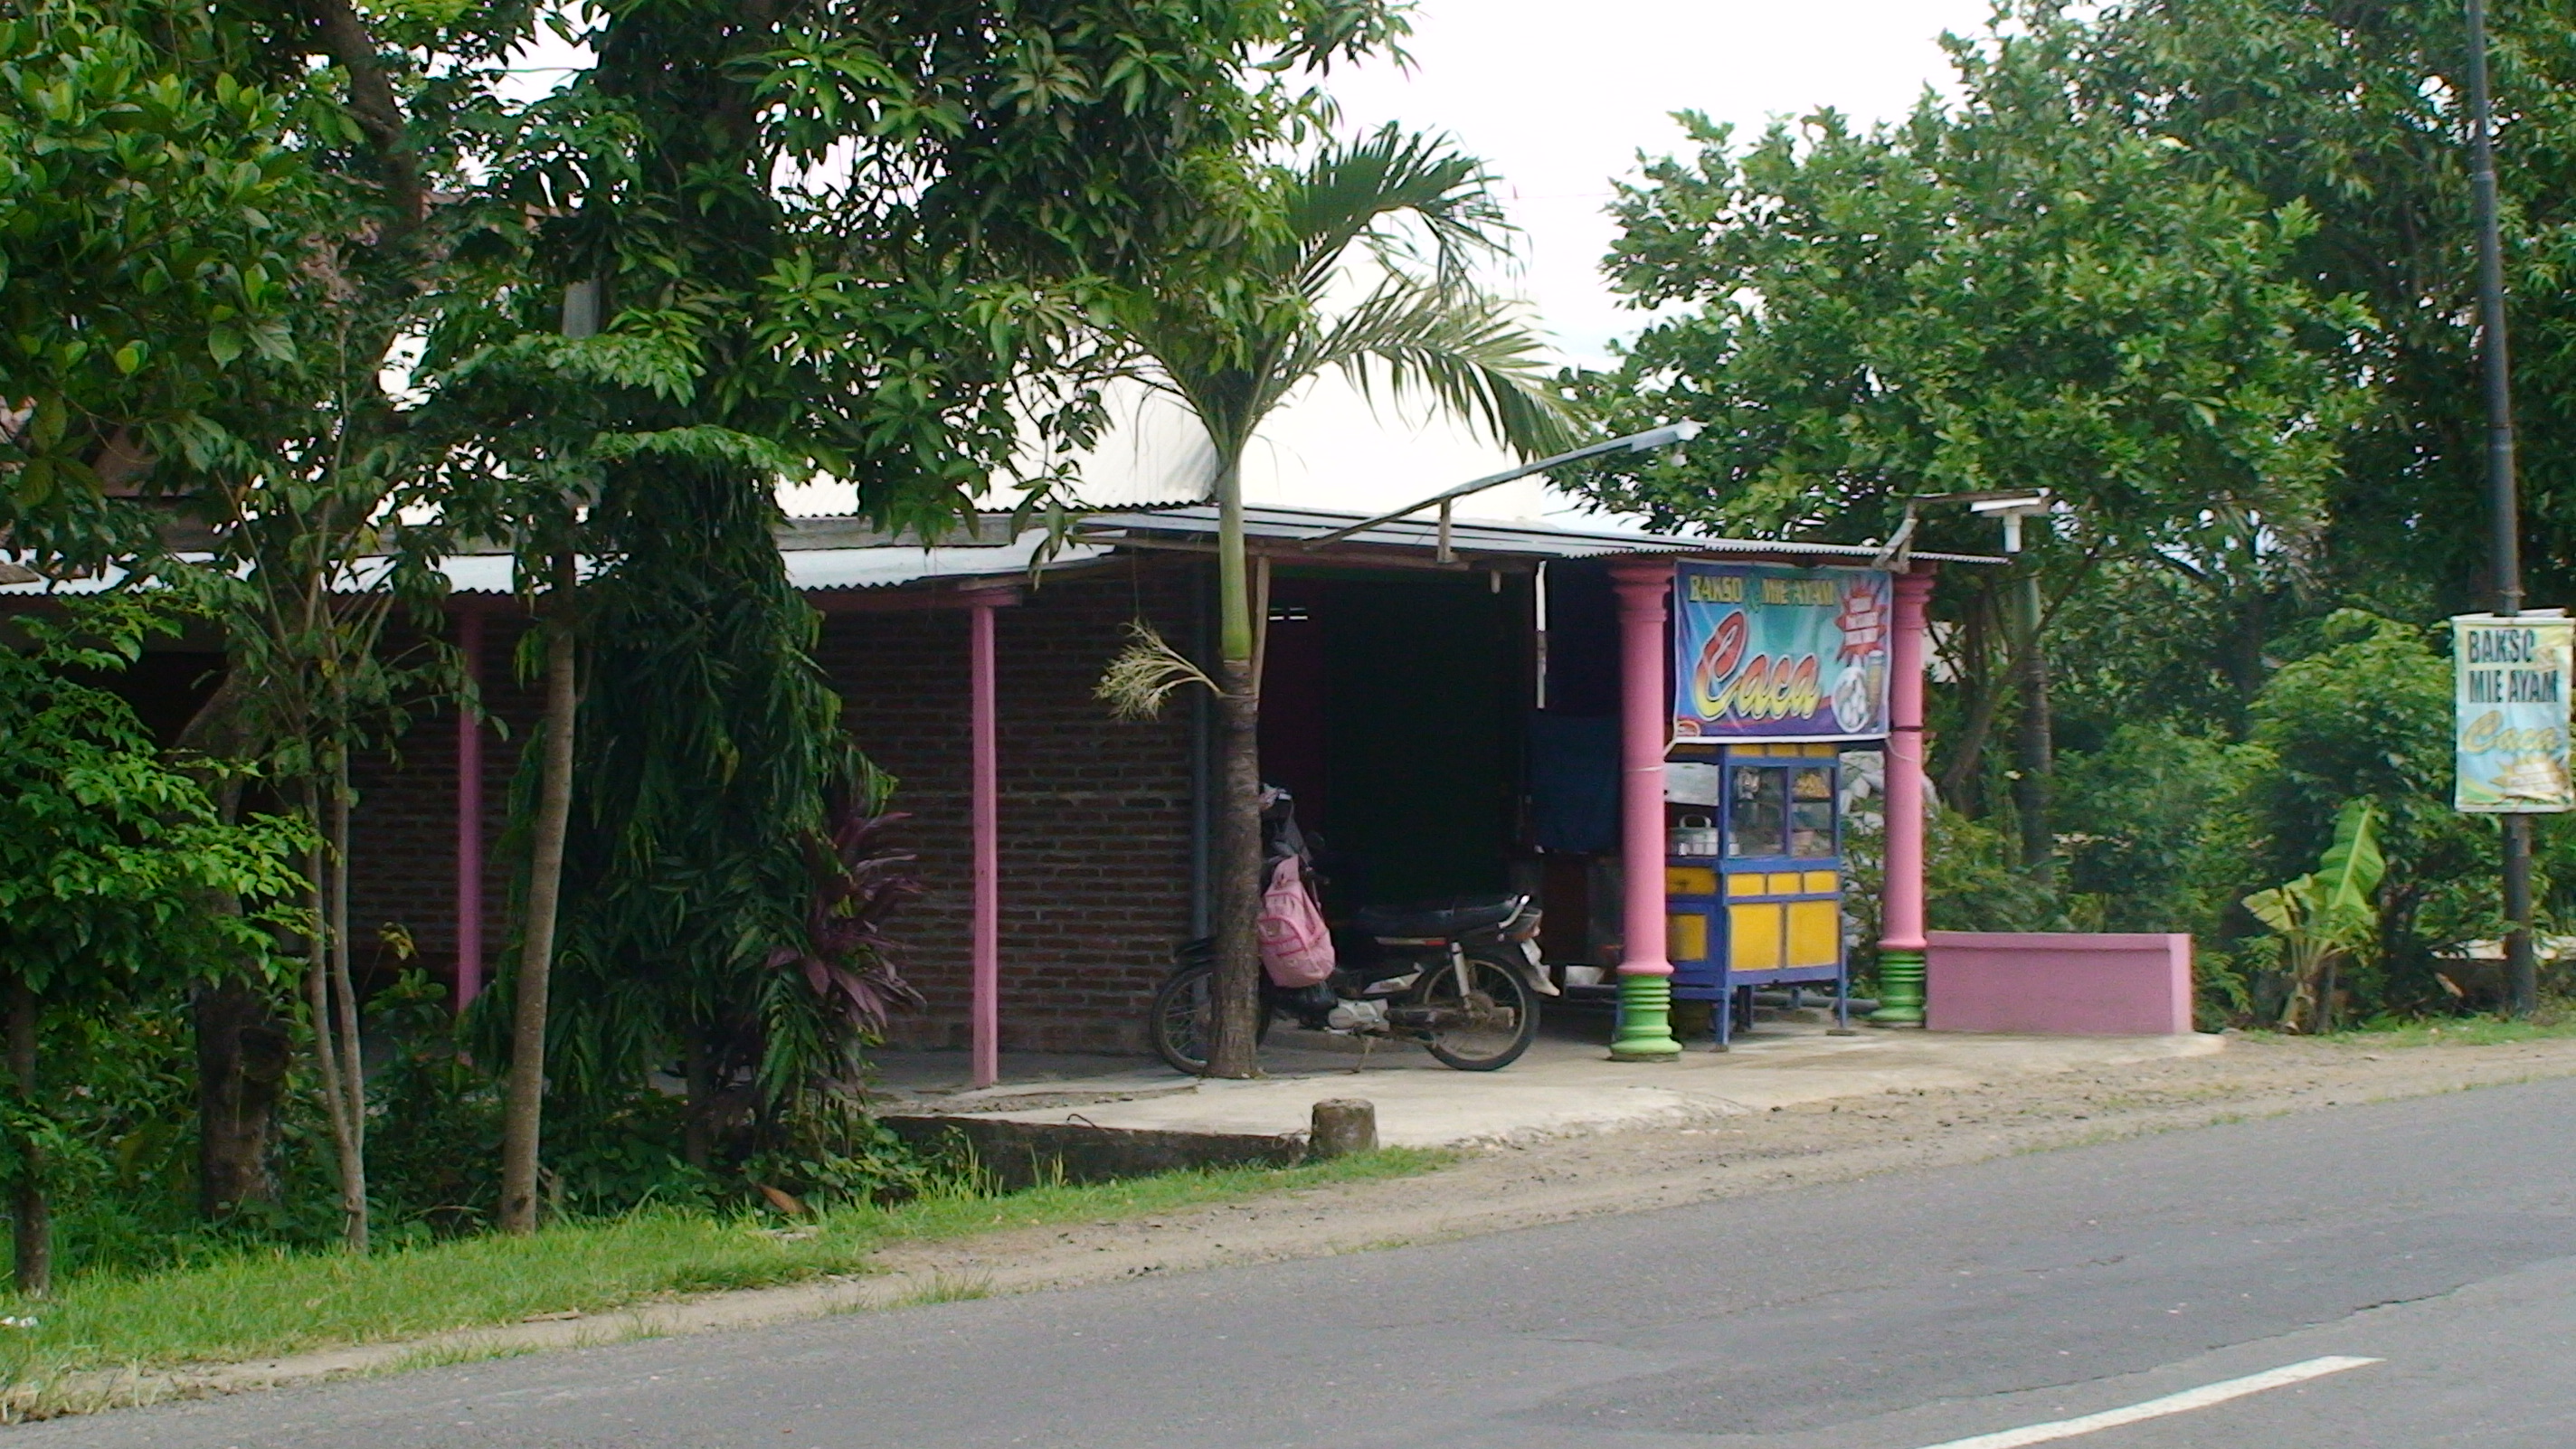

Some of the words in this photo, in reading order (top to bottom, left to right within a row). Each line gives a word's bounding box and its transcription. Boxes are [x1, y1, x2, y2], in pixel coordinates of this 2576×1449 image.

[1690, 575, 1742, 601] BAKSO
[1694, 609, 1822, 721] Caca
[2469, 670, 2503, 703] MIE
[2508, 669, 2558, 703] AYAM
